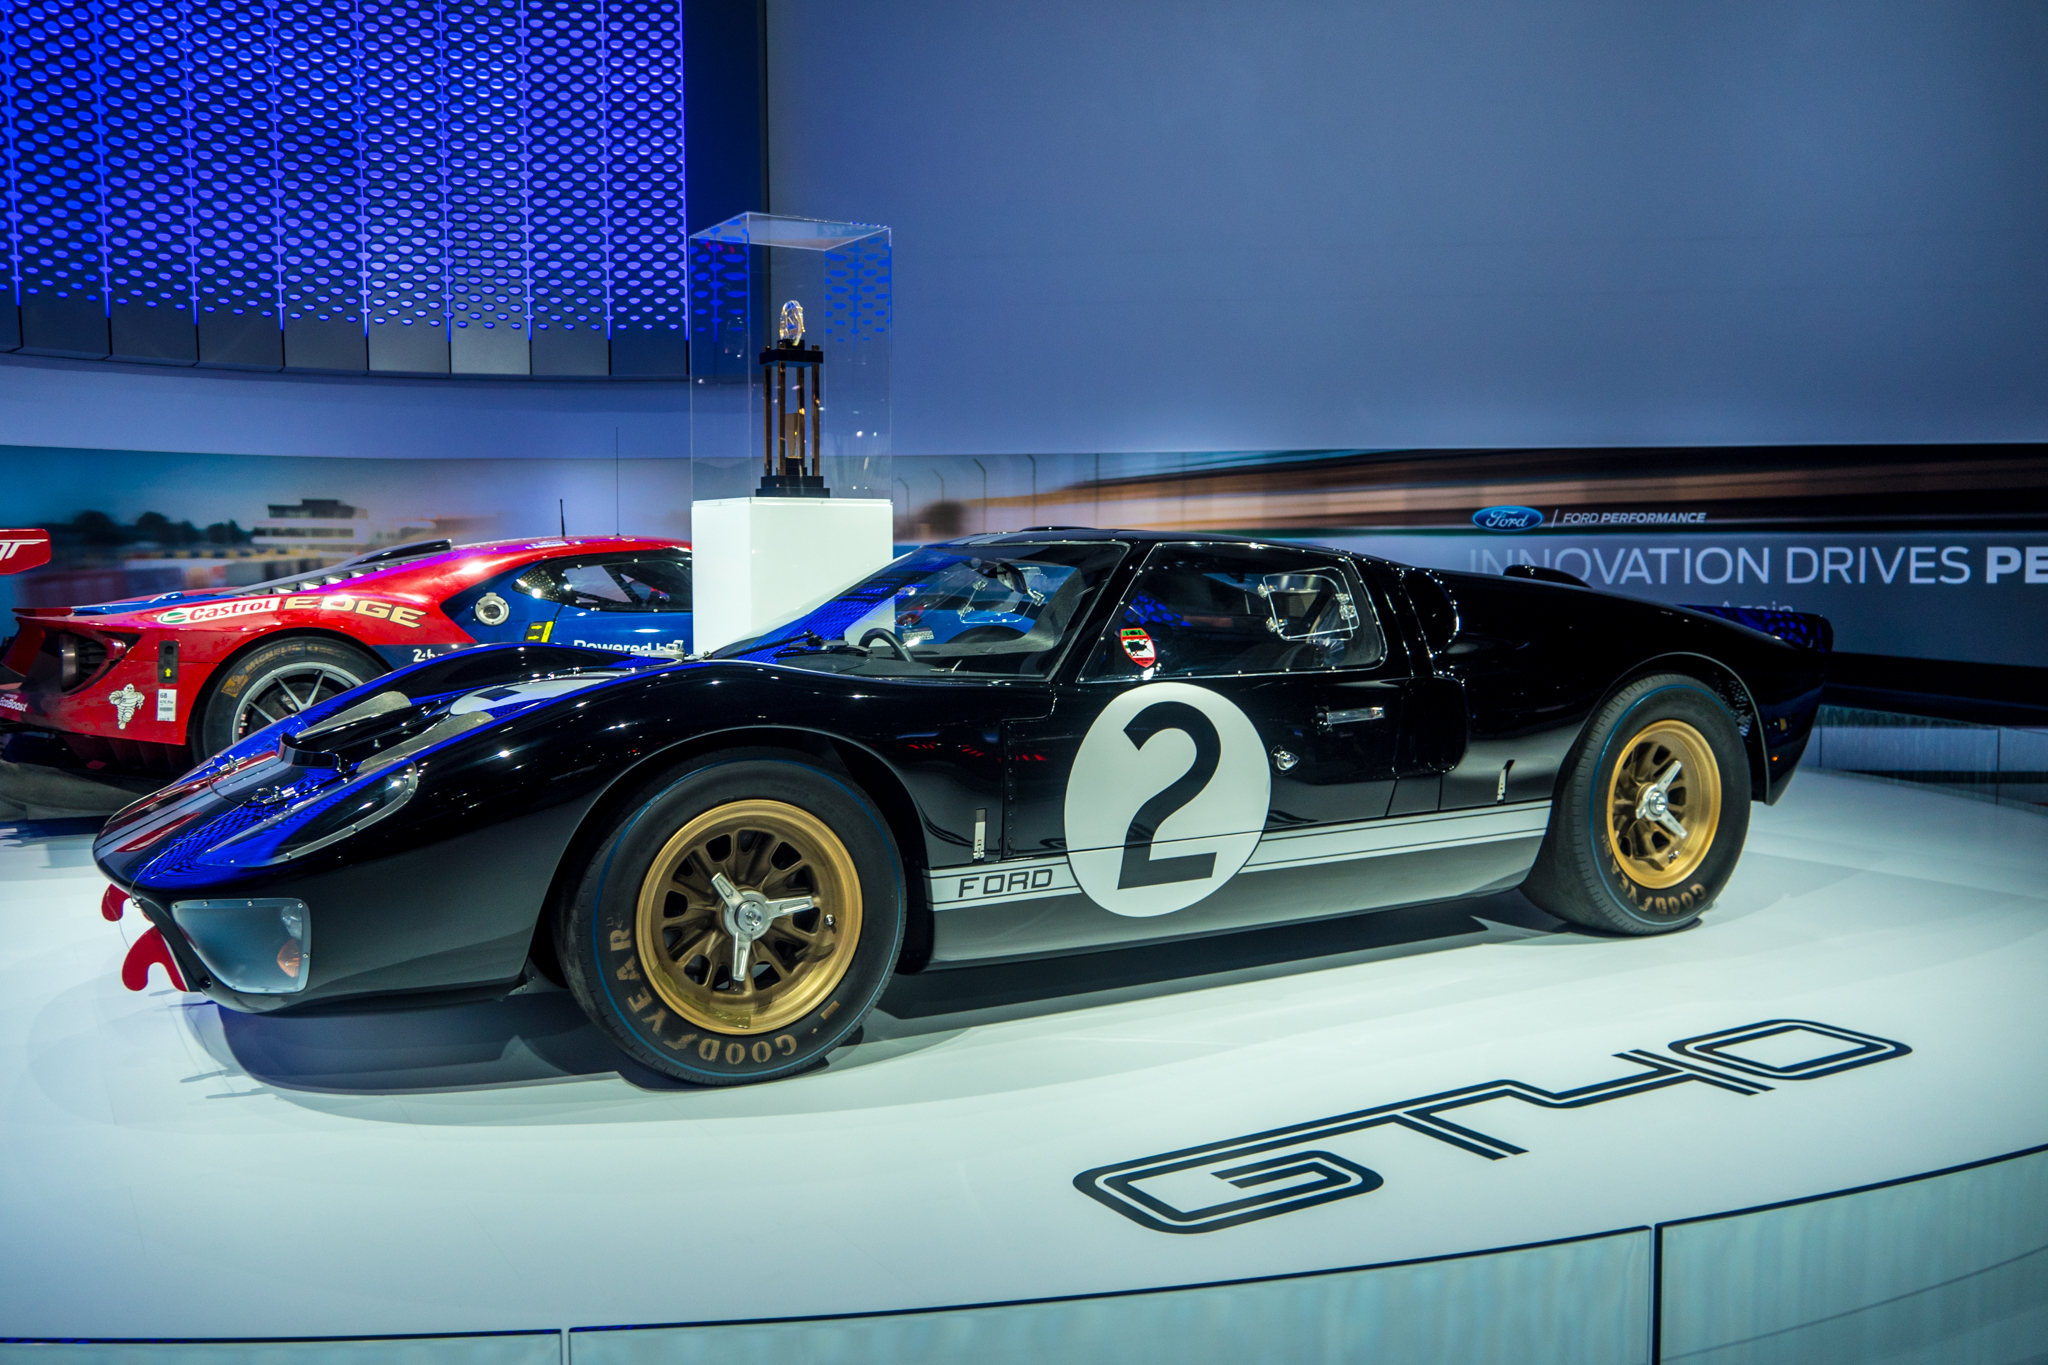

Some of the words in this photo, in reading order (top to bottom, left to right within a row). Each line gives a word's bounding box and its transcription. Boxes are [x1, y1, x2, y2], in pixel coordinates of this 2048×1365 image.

[1486, 510, 1529, 528] Ford
[1562, 512, 1599, 524] FORD
[1600, 512, 1707, 524] PERFORMANCE
[1469, 547, 1770, 585] INNOVATION
[1786, 546, 1971, 584] DRIVES
[189, 598, 273, 622] Castrol
[283, 595, 428, 629] EDGE
[1116, 700, 1222, 890] 2
[958, 868, 1053, 898] FORD
[1073, 1018, 1914, 1235] GT40
